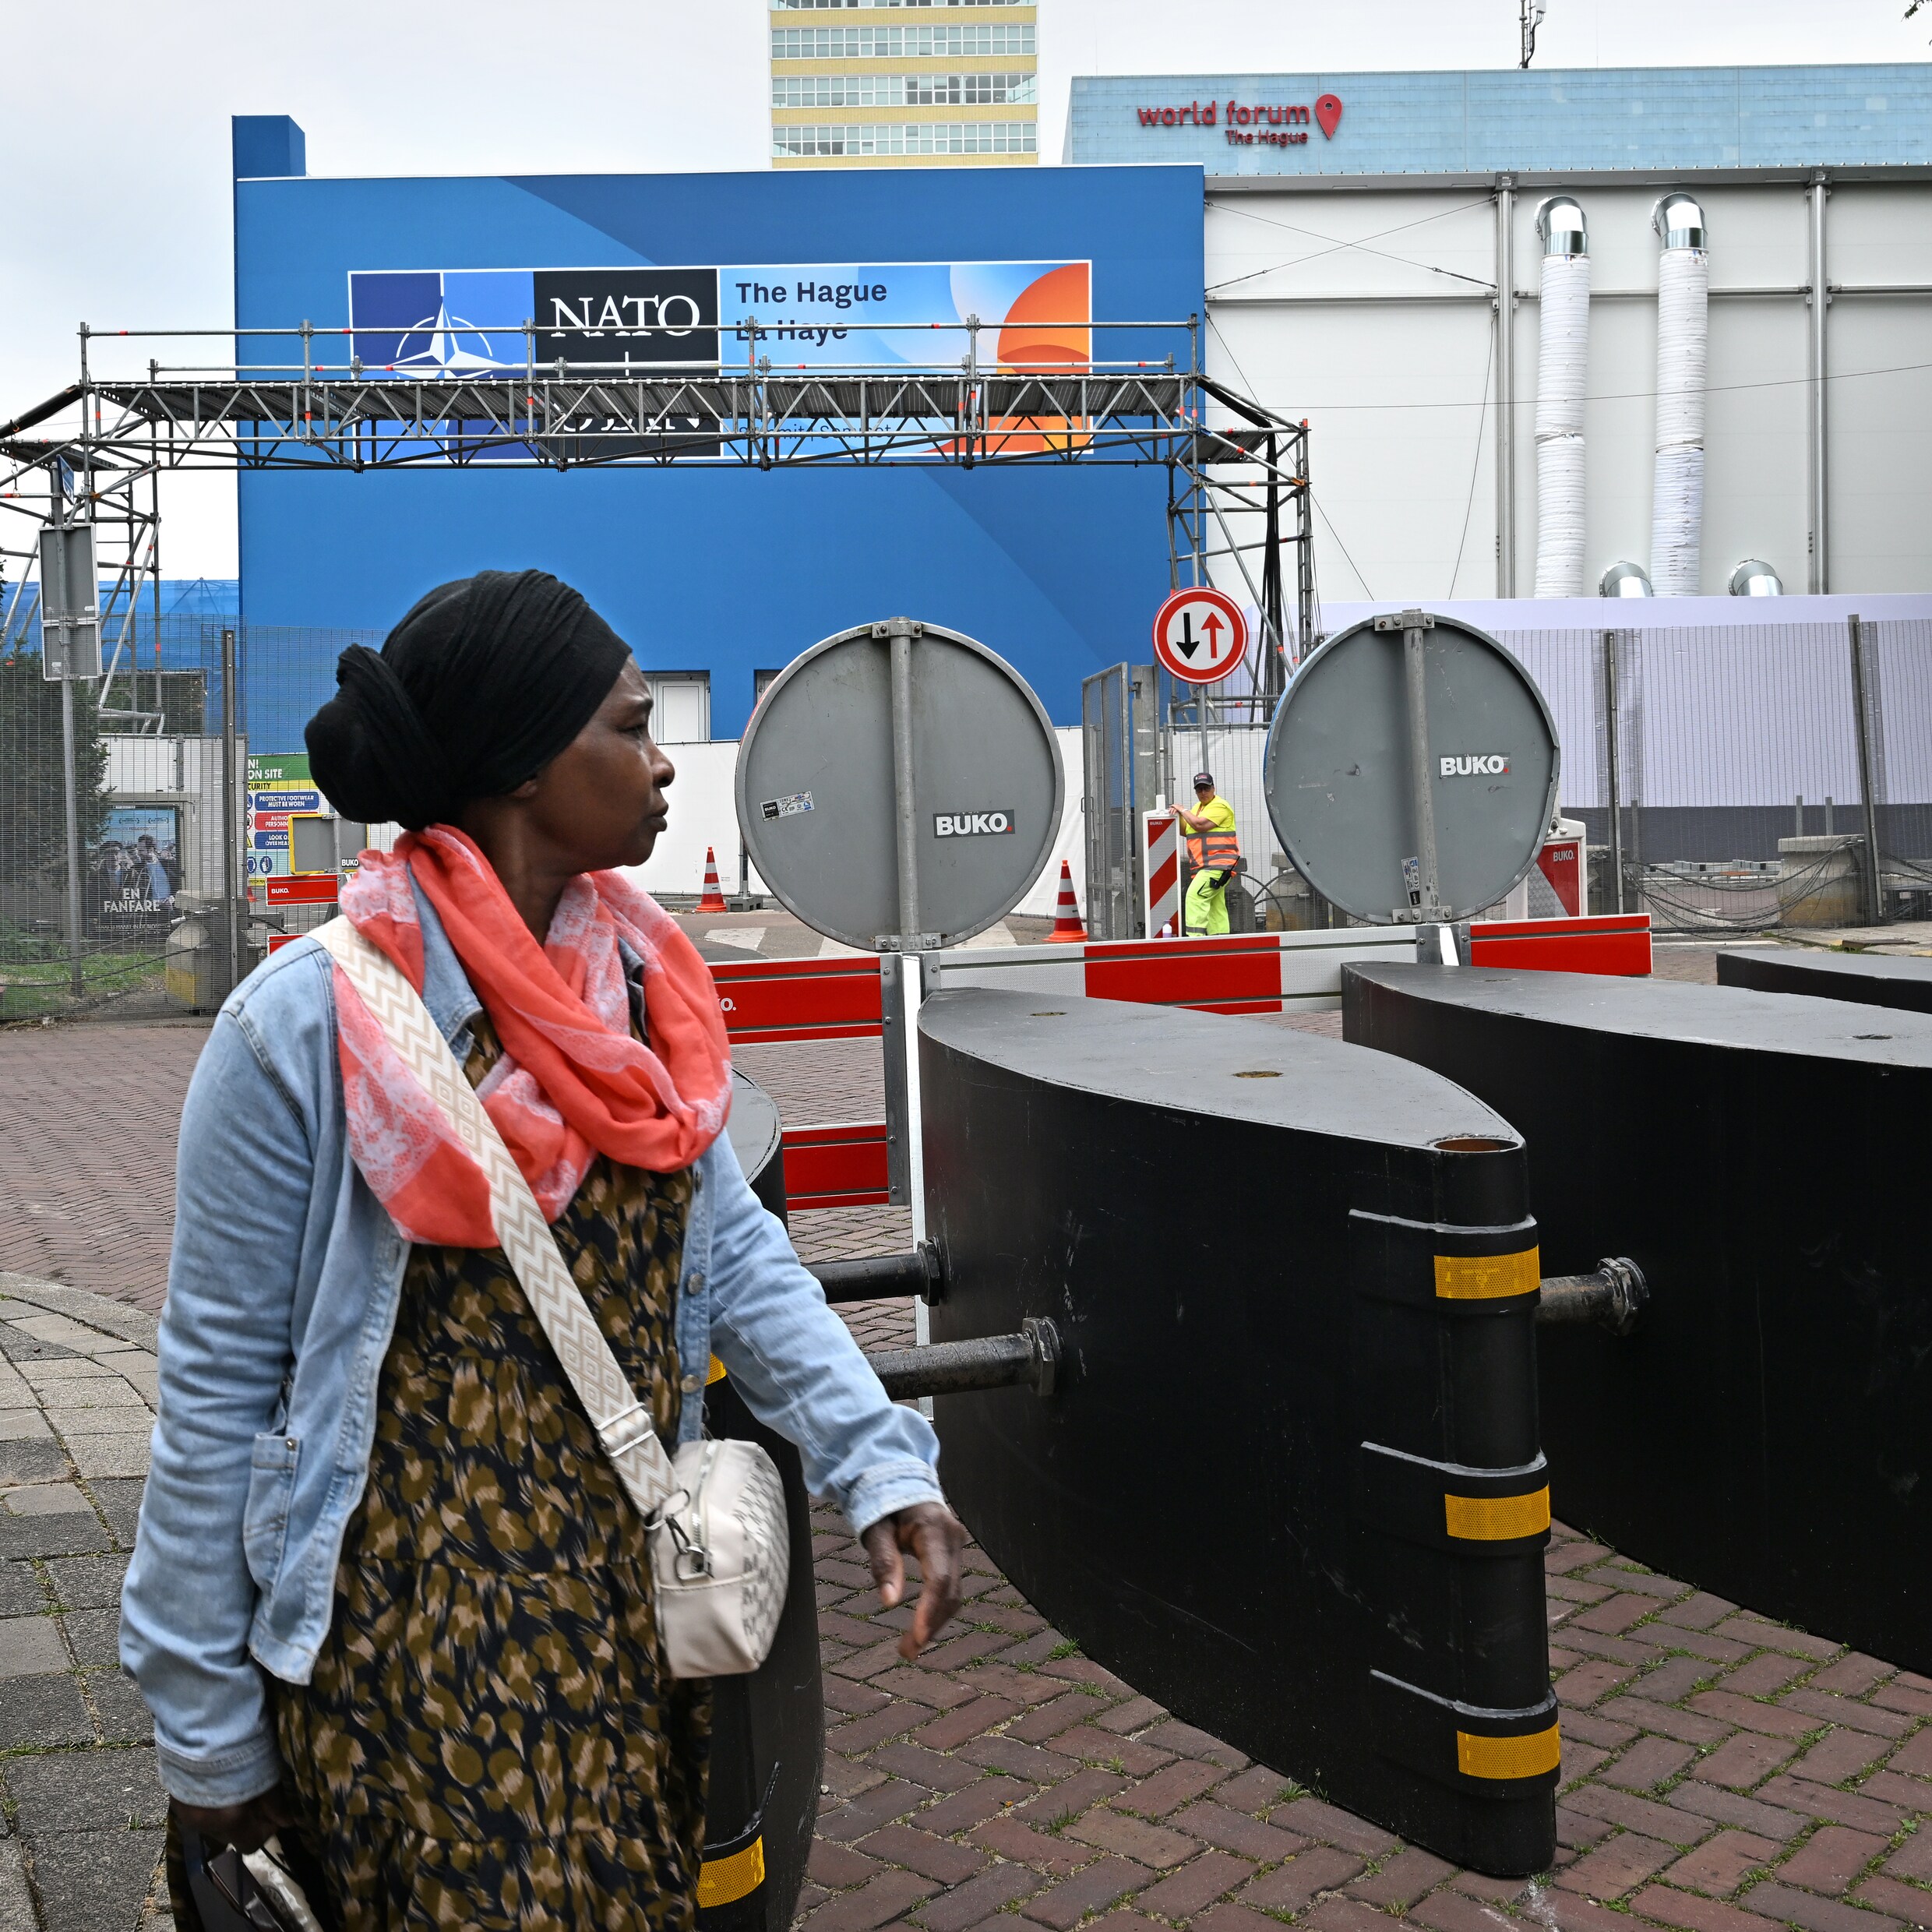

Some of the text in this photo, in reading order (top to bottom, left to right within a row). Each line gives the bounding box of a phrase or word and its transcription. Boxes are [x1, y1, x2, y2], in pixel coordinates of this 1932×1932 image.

[1137, 100, 1310, 125] world forum
[1225, 129, 1309, 146] The Hague
[735, 281, 887, 309] The Hague
[549, 294, 700, 337] NATO
[777, 319, 848, 347] Haye
[265, 768, 283, 779] SITE
[1440, 754, 1509, 776] BUKO.
[936, 813, 1013, 836] BUKO.
[1553, 850, 1575, 862] BUKO.
[123, 888, 141, 900] EN
[104, 900, 161, 913] FANFARE
